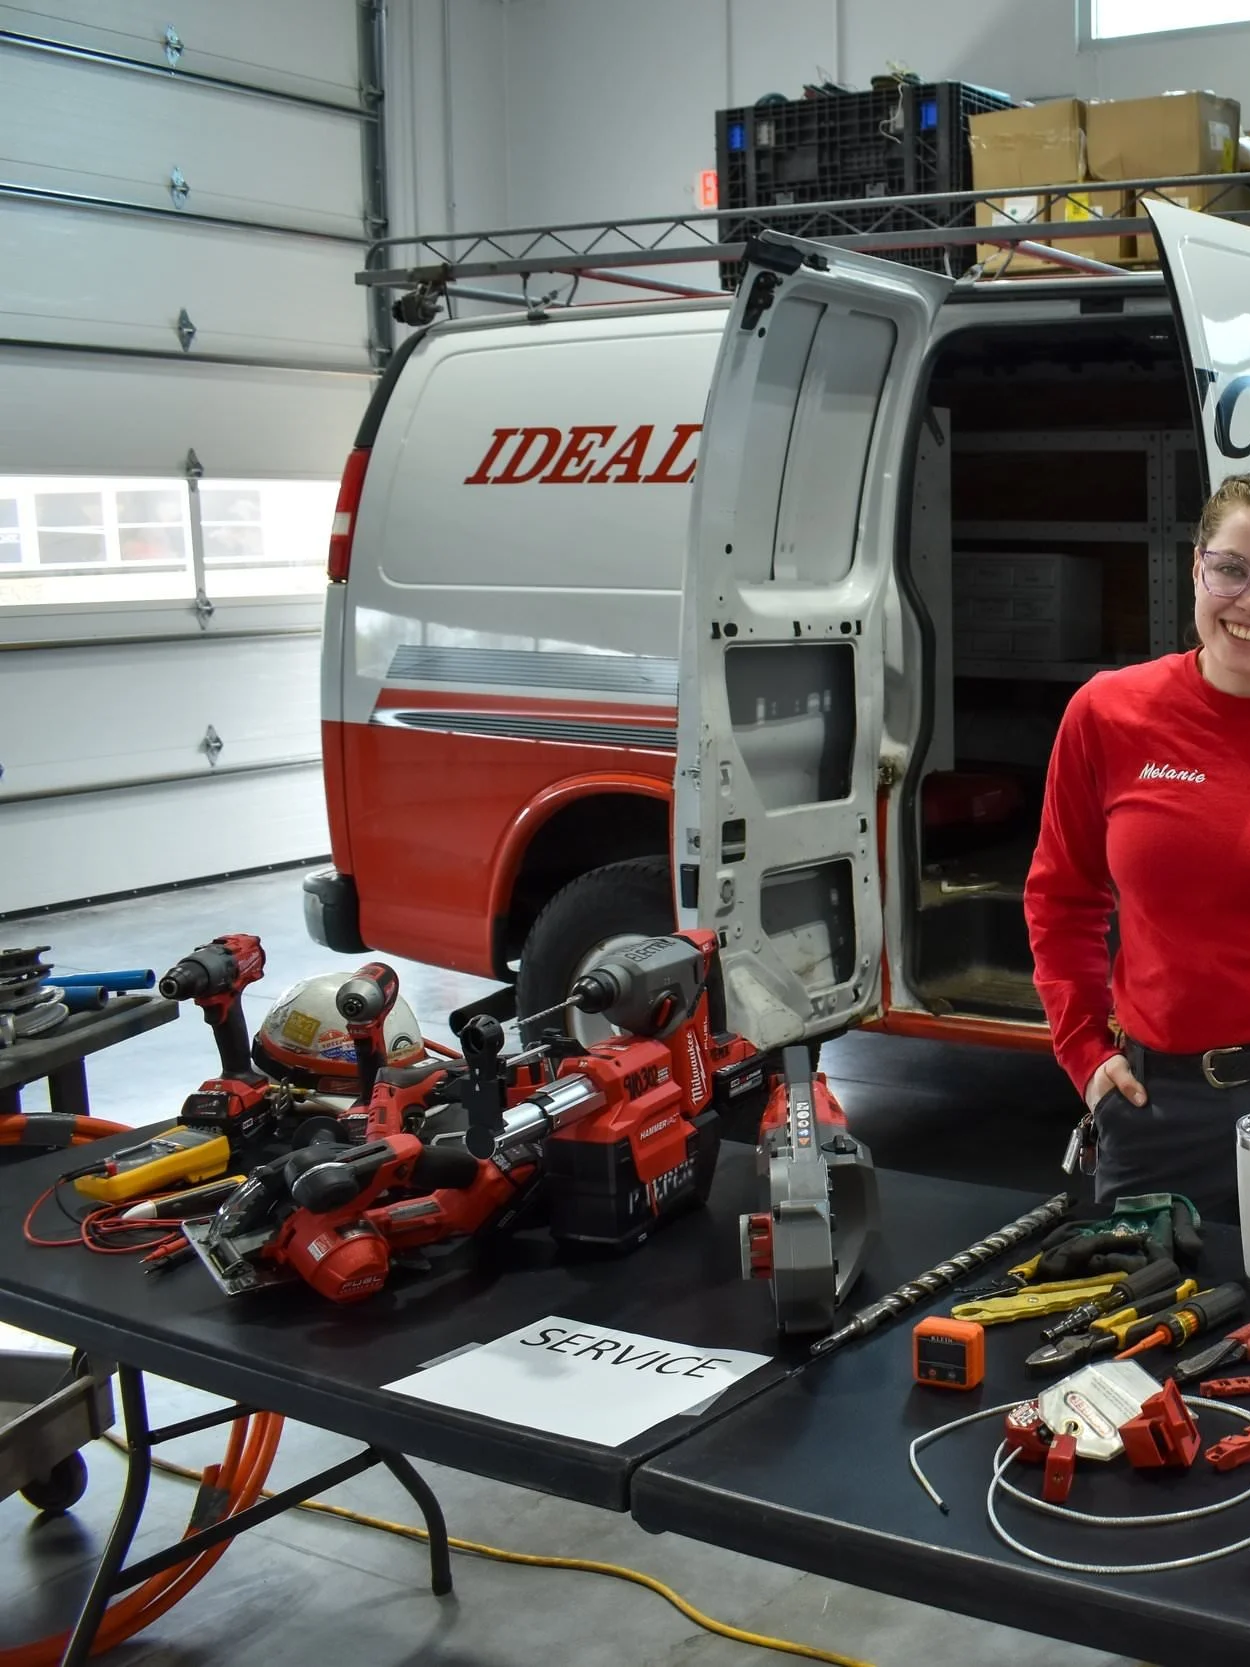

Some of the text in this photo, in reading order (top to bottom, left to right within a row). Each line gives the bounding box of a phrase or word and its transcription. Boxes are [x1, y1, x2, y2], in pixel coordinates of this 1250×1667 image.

[463, 423, 704, 485] IDEAL
[1138, 761, 1206, 784] Melanie
[686, 1030, 705, 1105] Milwaukee
[519, 1328, 732, 1378] SERVICE
